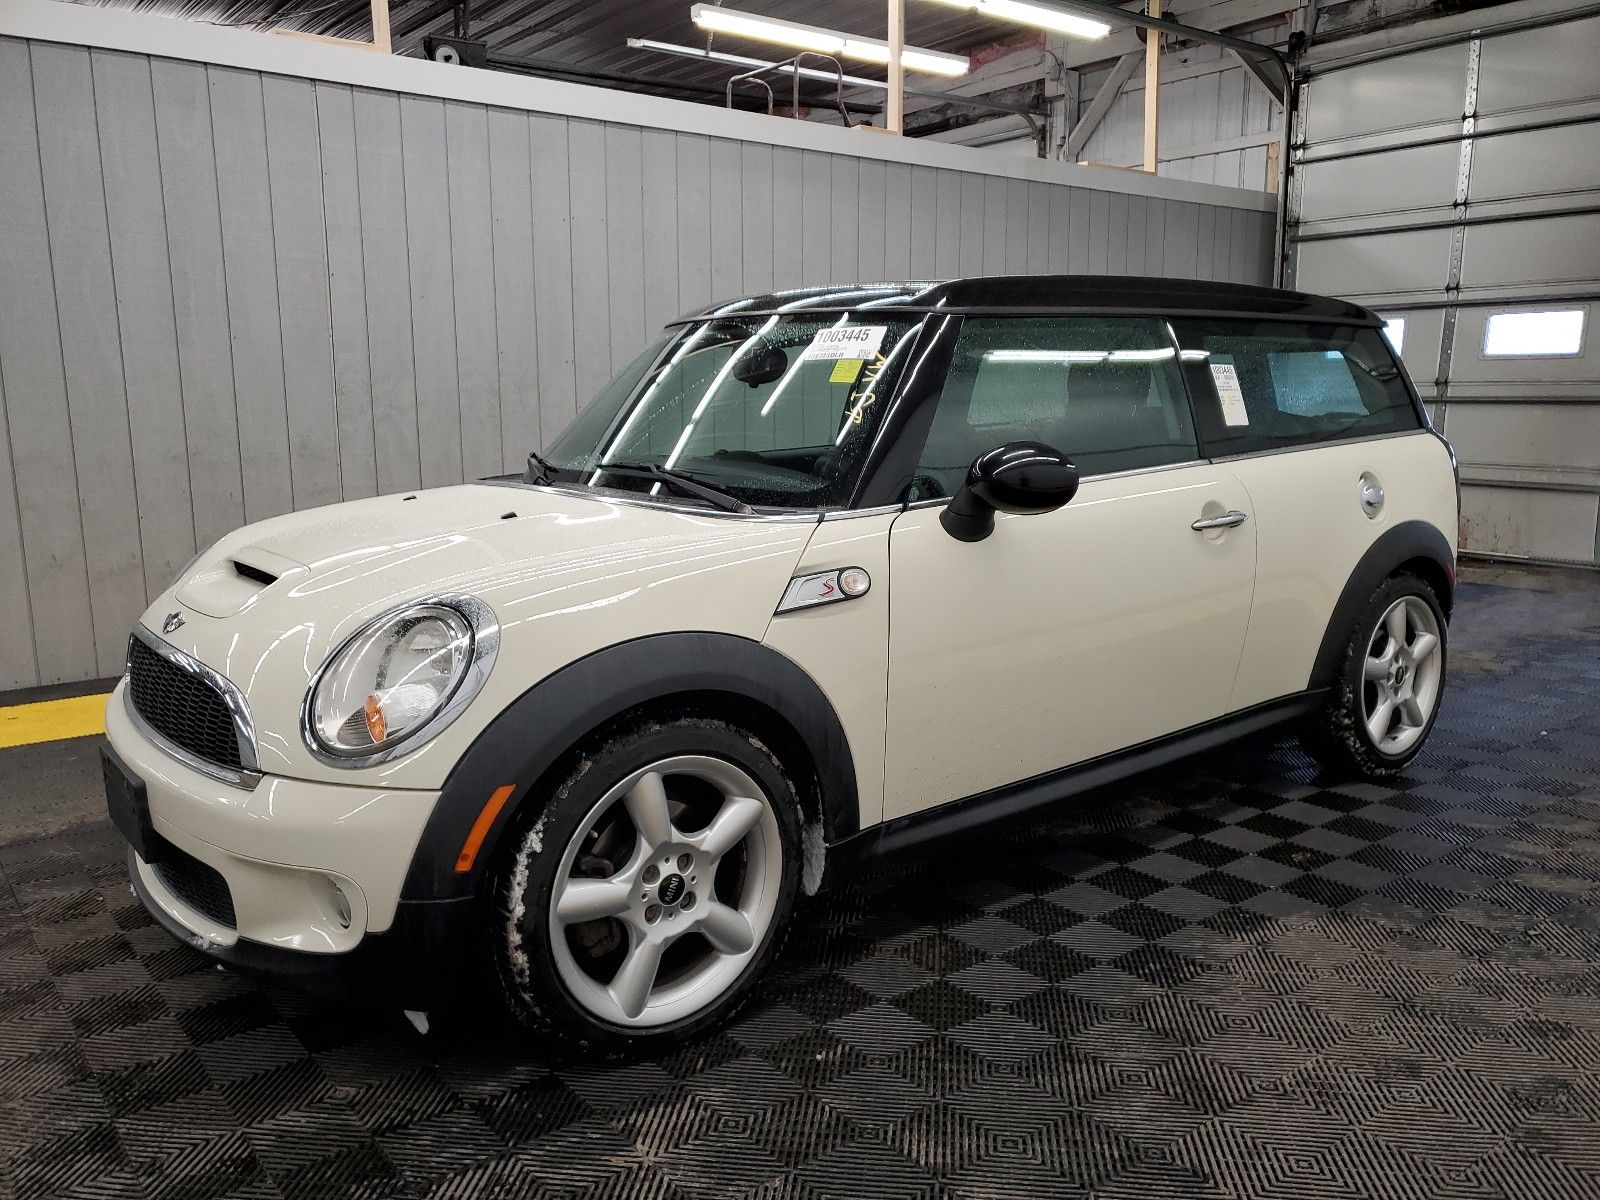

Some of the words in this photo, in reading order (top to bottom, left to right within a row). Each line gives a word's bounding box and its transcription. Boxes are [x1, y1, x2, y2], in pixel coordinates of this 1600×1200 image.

[817, 328, 871, 343] 1003445
[818, 577, 835, 597] S
[664, 877, 680, 902] MINI
